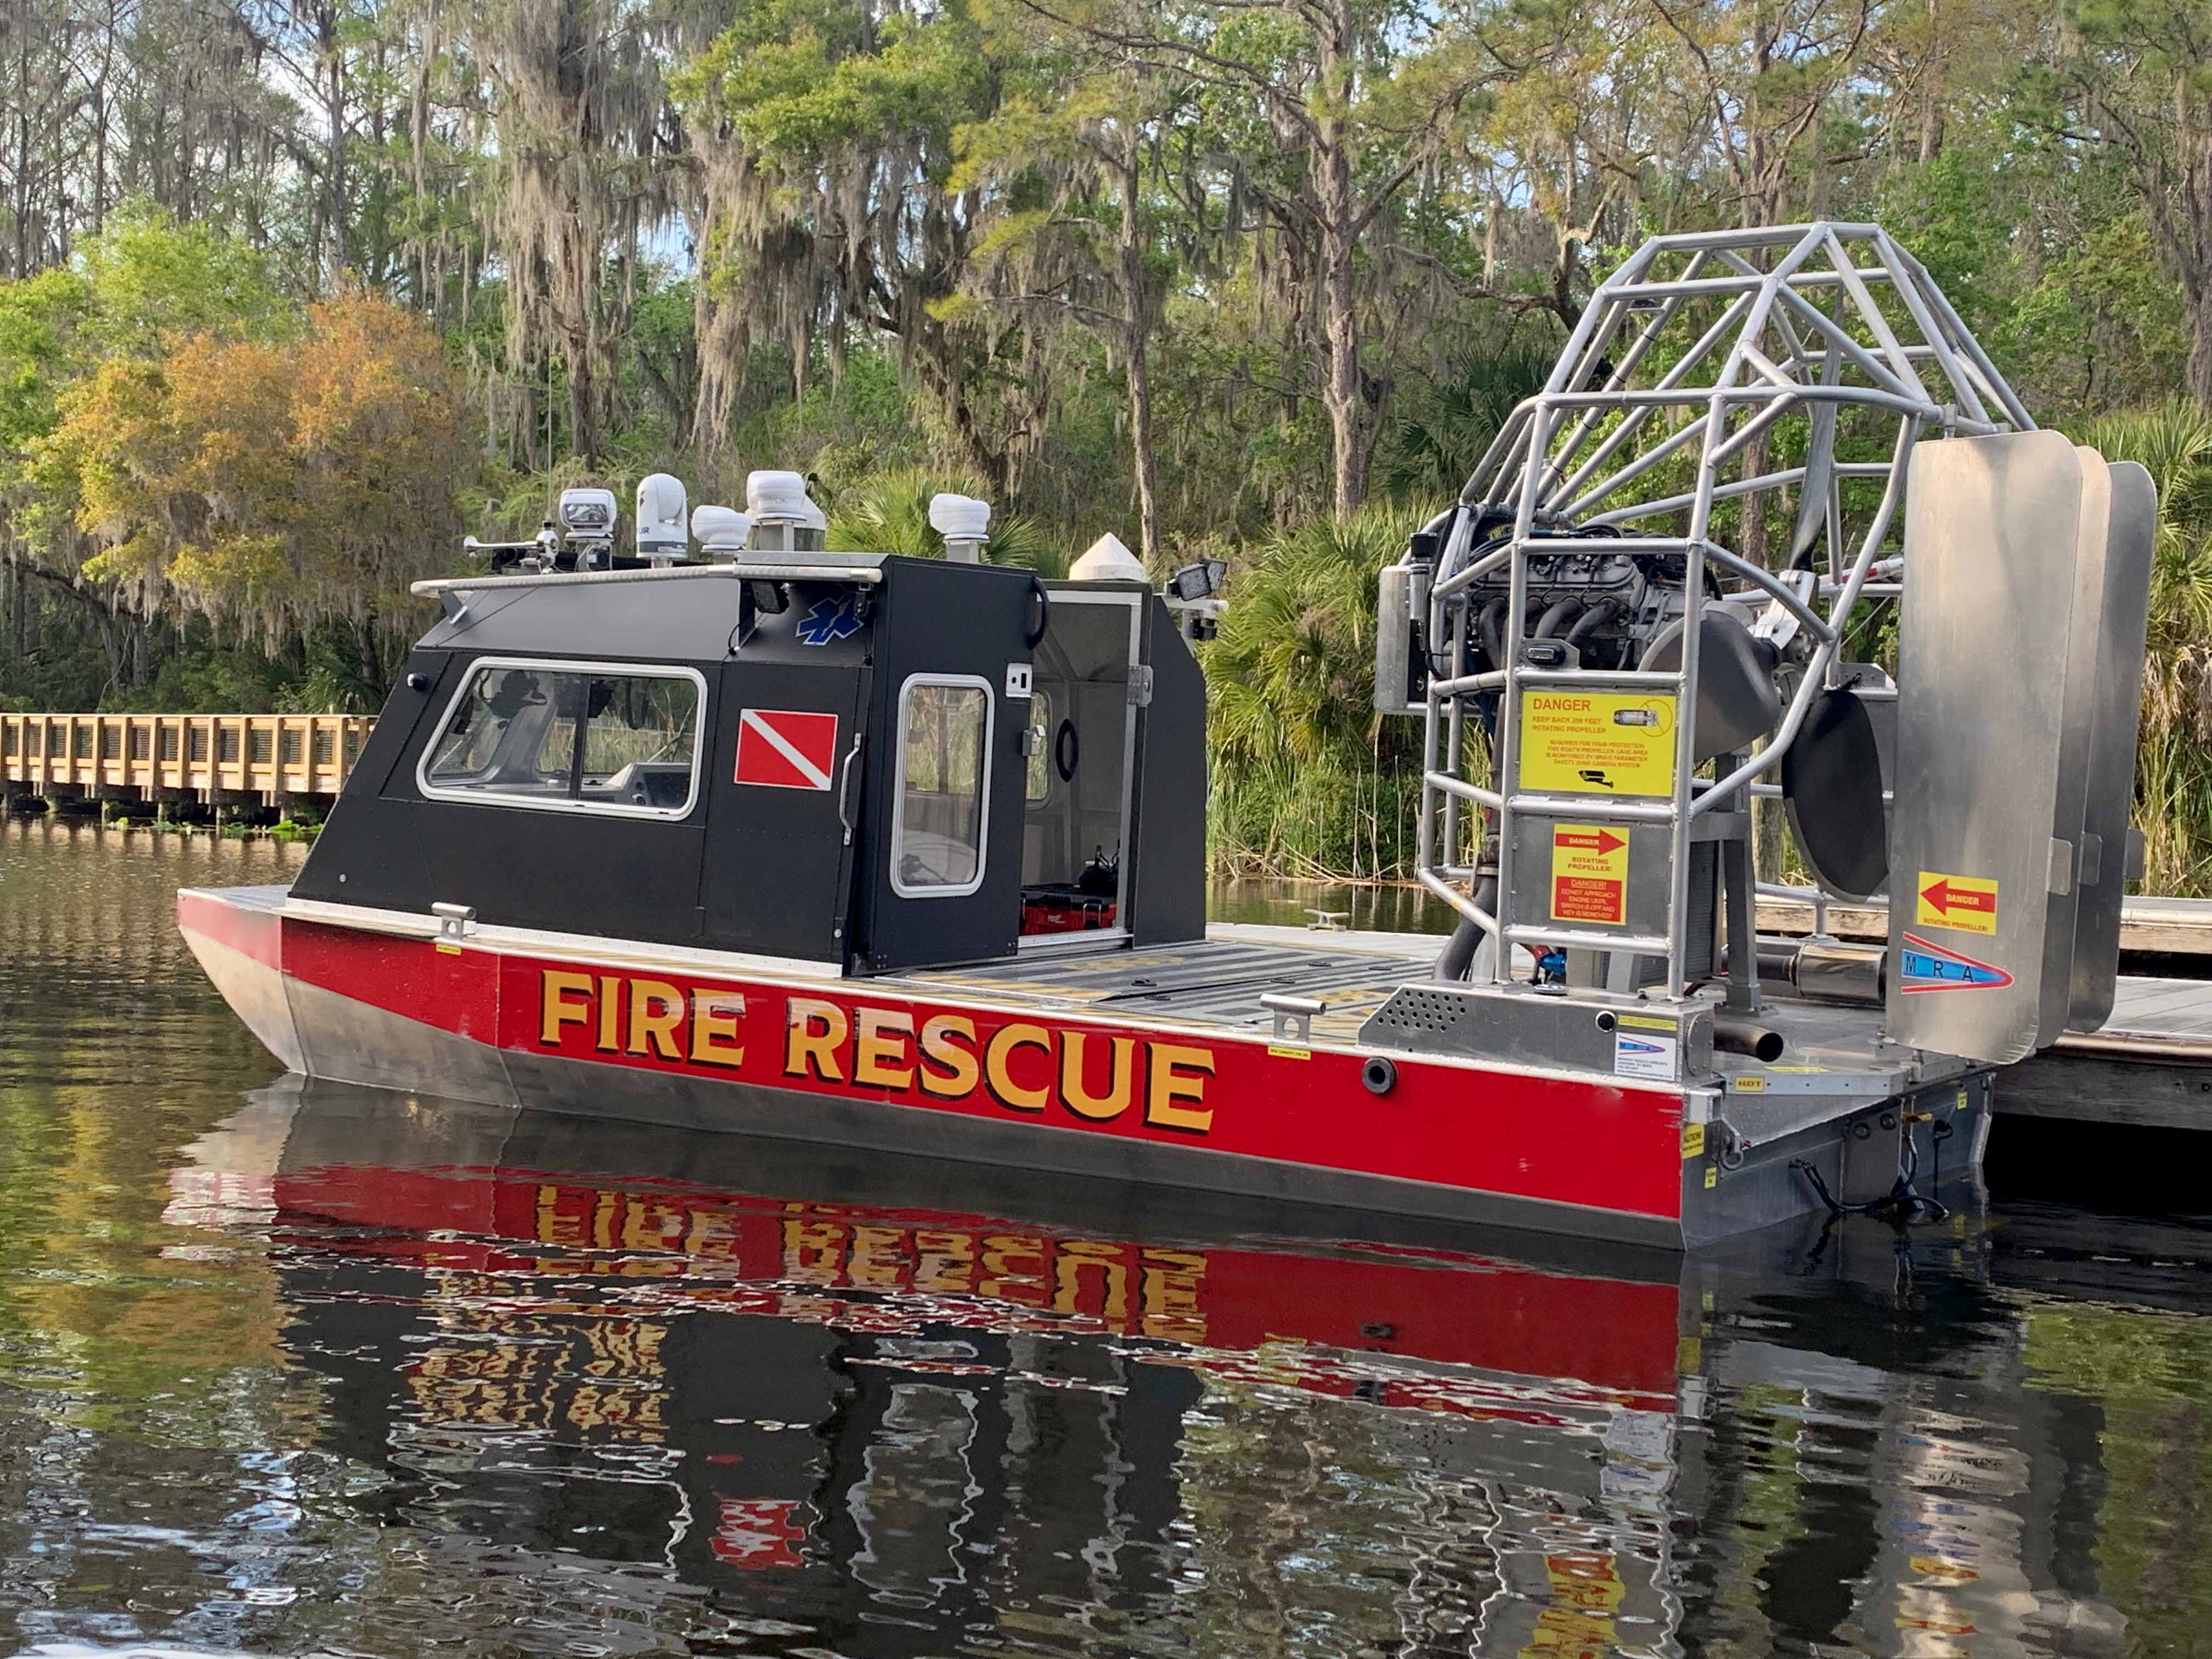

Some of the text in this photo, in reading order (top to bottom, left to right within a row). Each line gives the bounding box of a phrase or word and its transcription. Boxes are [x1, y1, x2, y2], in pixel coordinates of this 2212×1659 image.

[1533, 698, 1590, 711] DANGER
[1568, 837, 1599, 845] DANGER
[1946, 894, 1979, 906] DANGER
[1923, 917, 1950, 927] ROTATING
[539, 969, 1215, 1136] FIRE RESCUE
